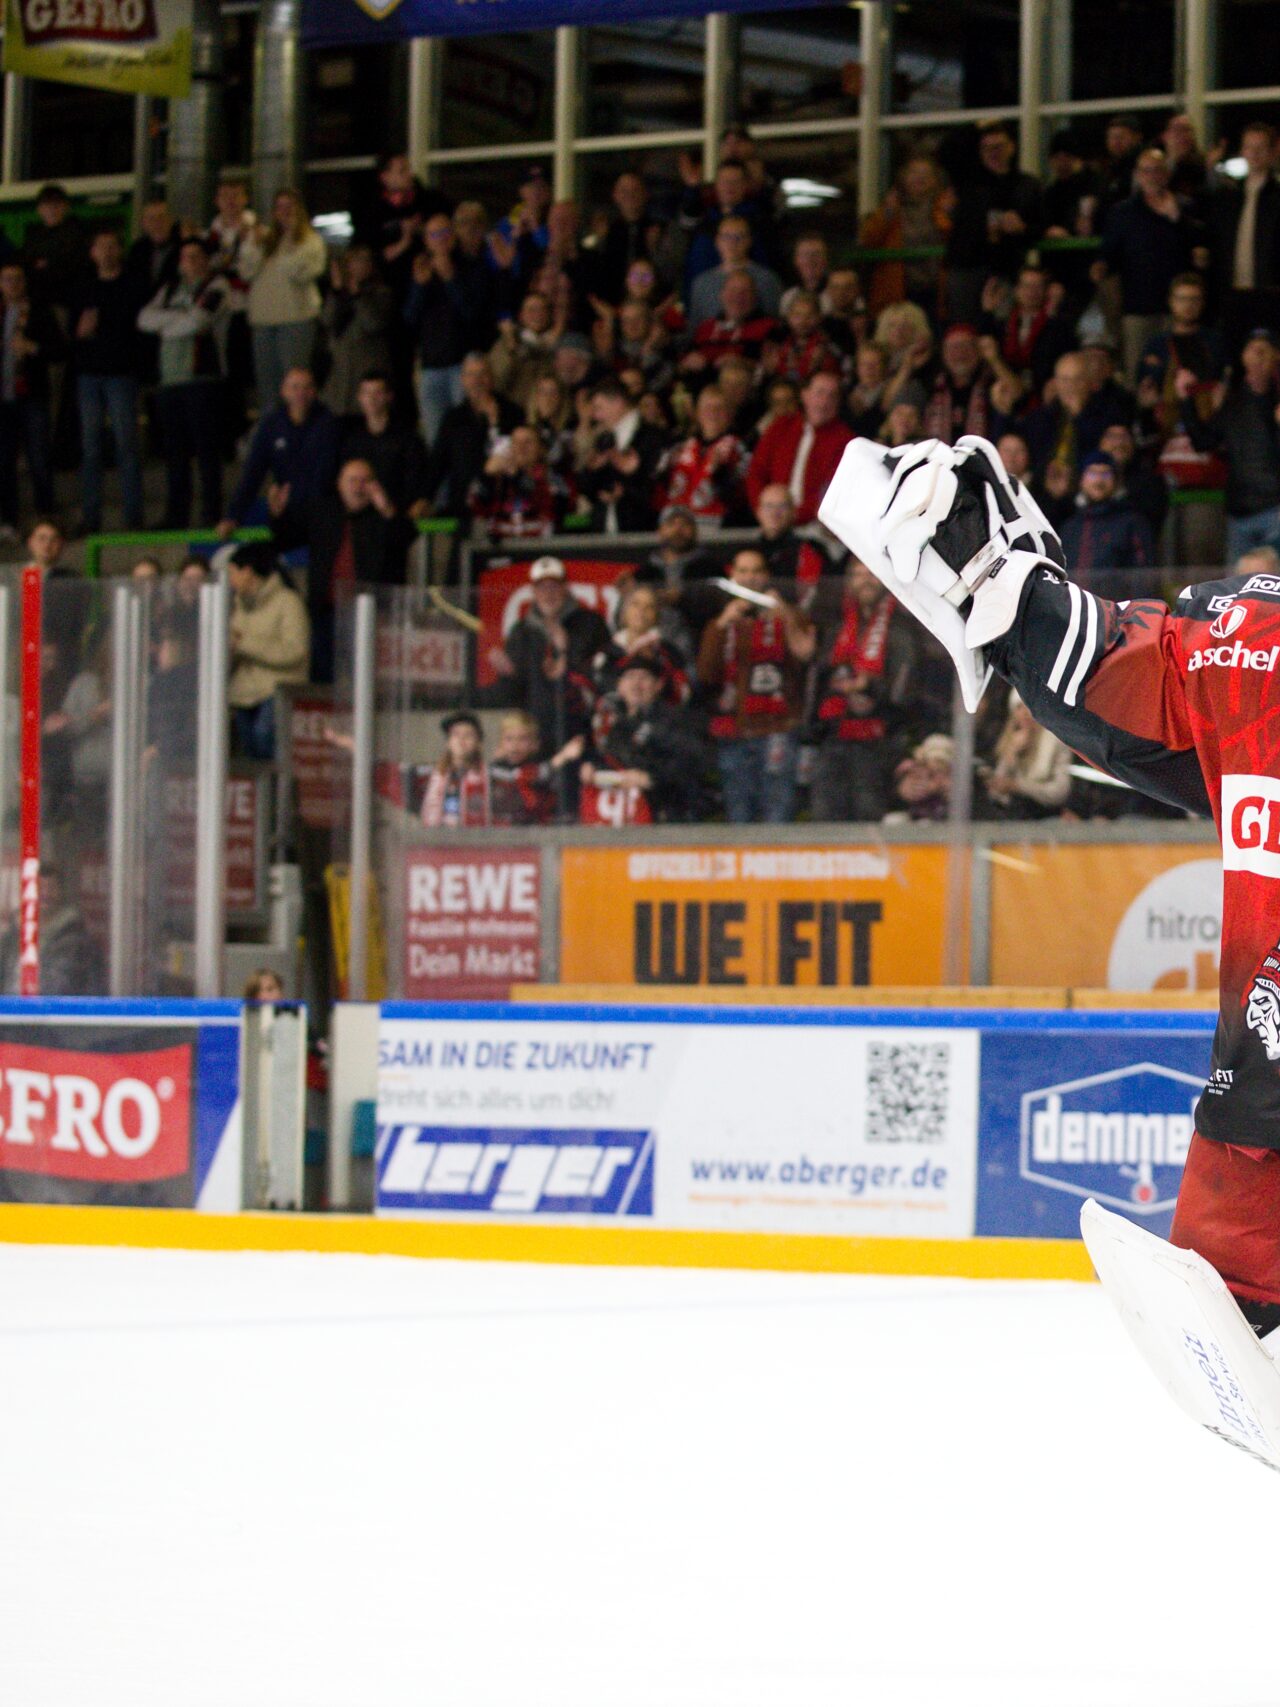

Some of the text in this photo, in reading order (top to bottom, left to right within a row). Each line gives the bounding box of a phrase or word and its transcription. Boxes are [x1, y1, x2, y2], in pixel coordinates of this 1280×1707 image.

[408, 863, 537, 913] REWE
[408, 943, 536, 976] Dein Markt
[634, 901, 883, 986] WE FIT
[440, 1041, 468, 1067] IN
[474, 1042, 519, 1069] DIE
[526, 1043, 653, 1070] ZUKUNFT
[0, 1067, 161, 1159] FRO
[1032, 1093, 1199, 1165] demme
[380, 1126, 635, 1212] berger
[690, 1154, 947, 1196] www.aberger.de
